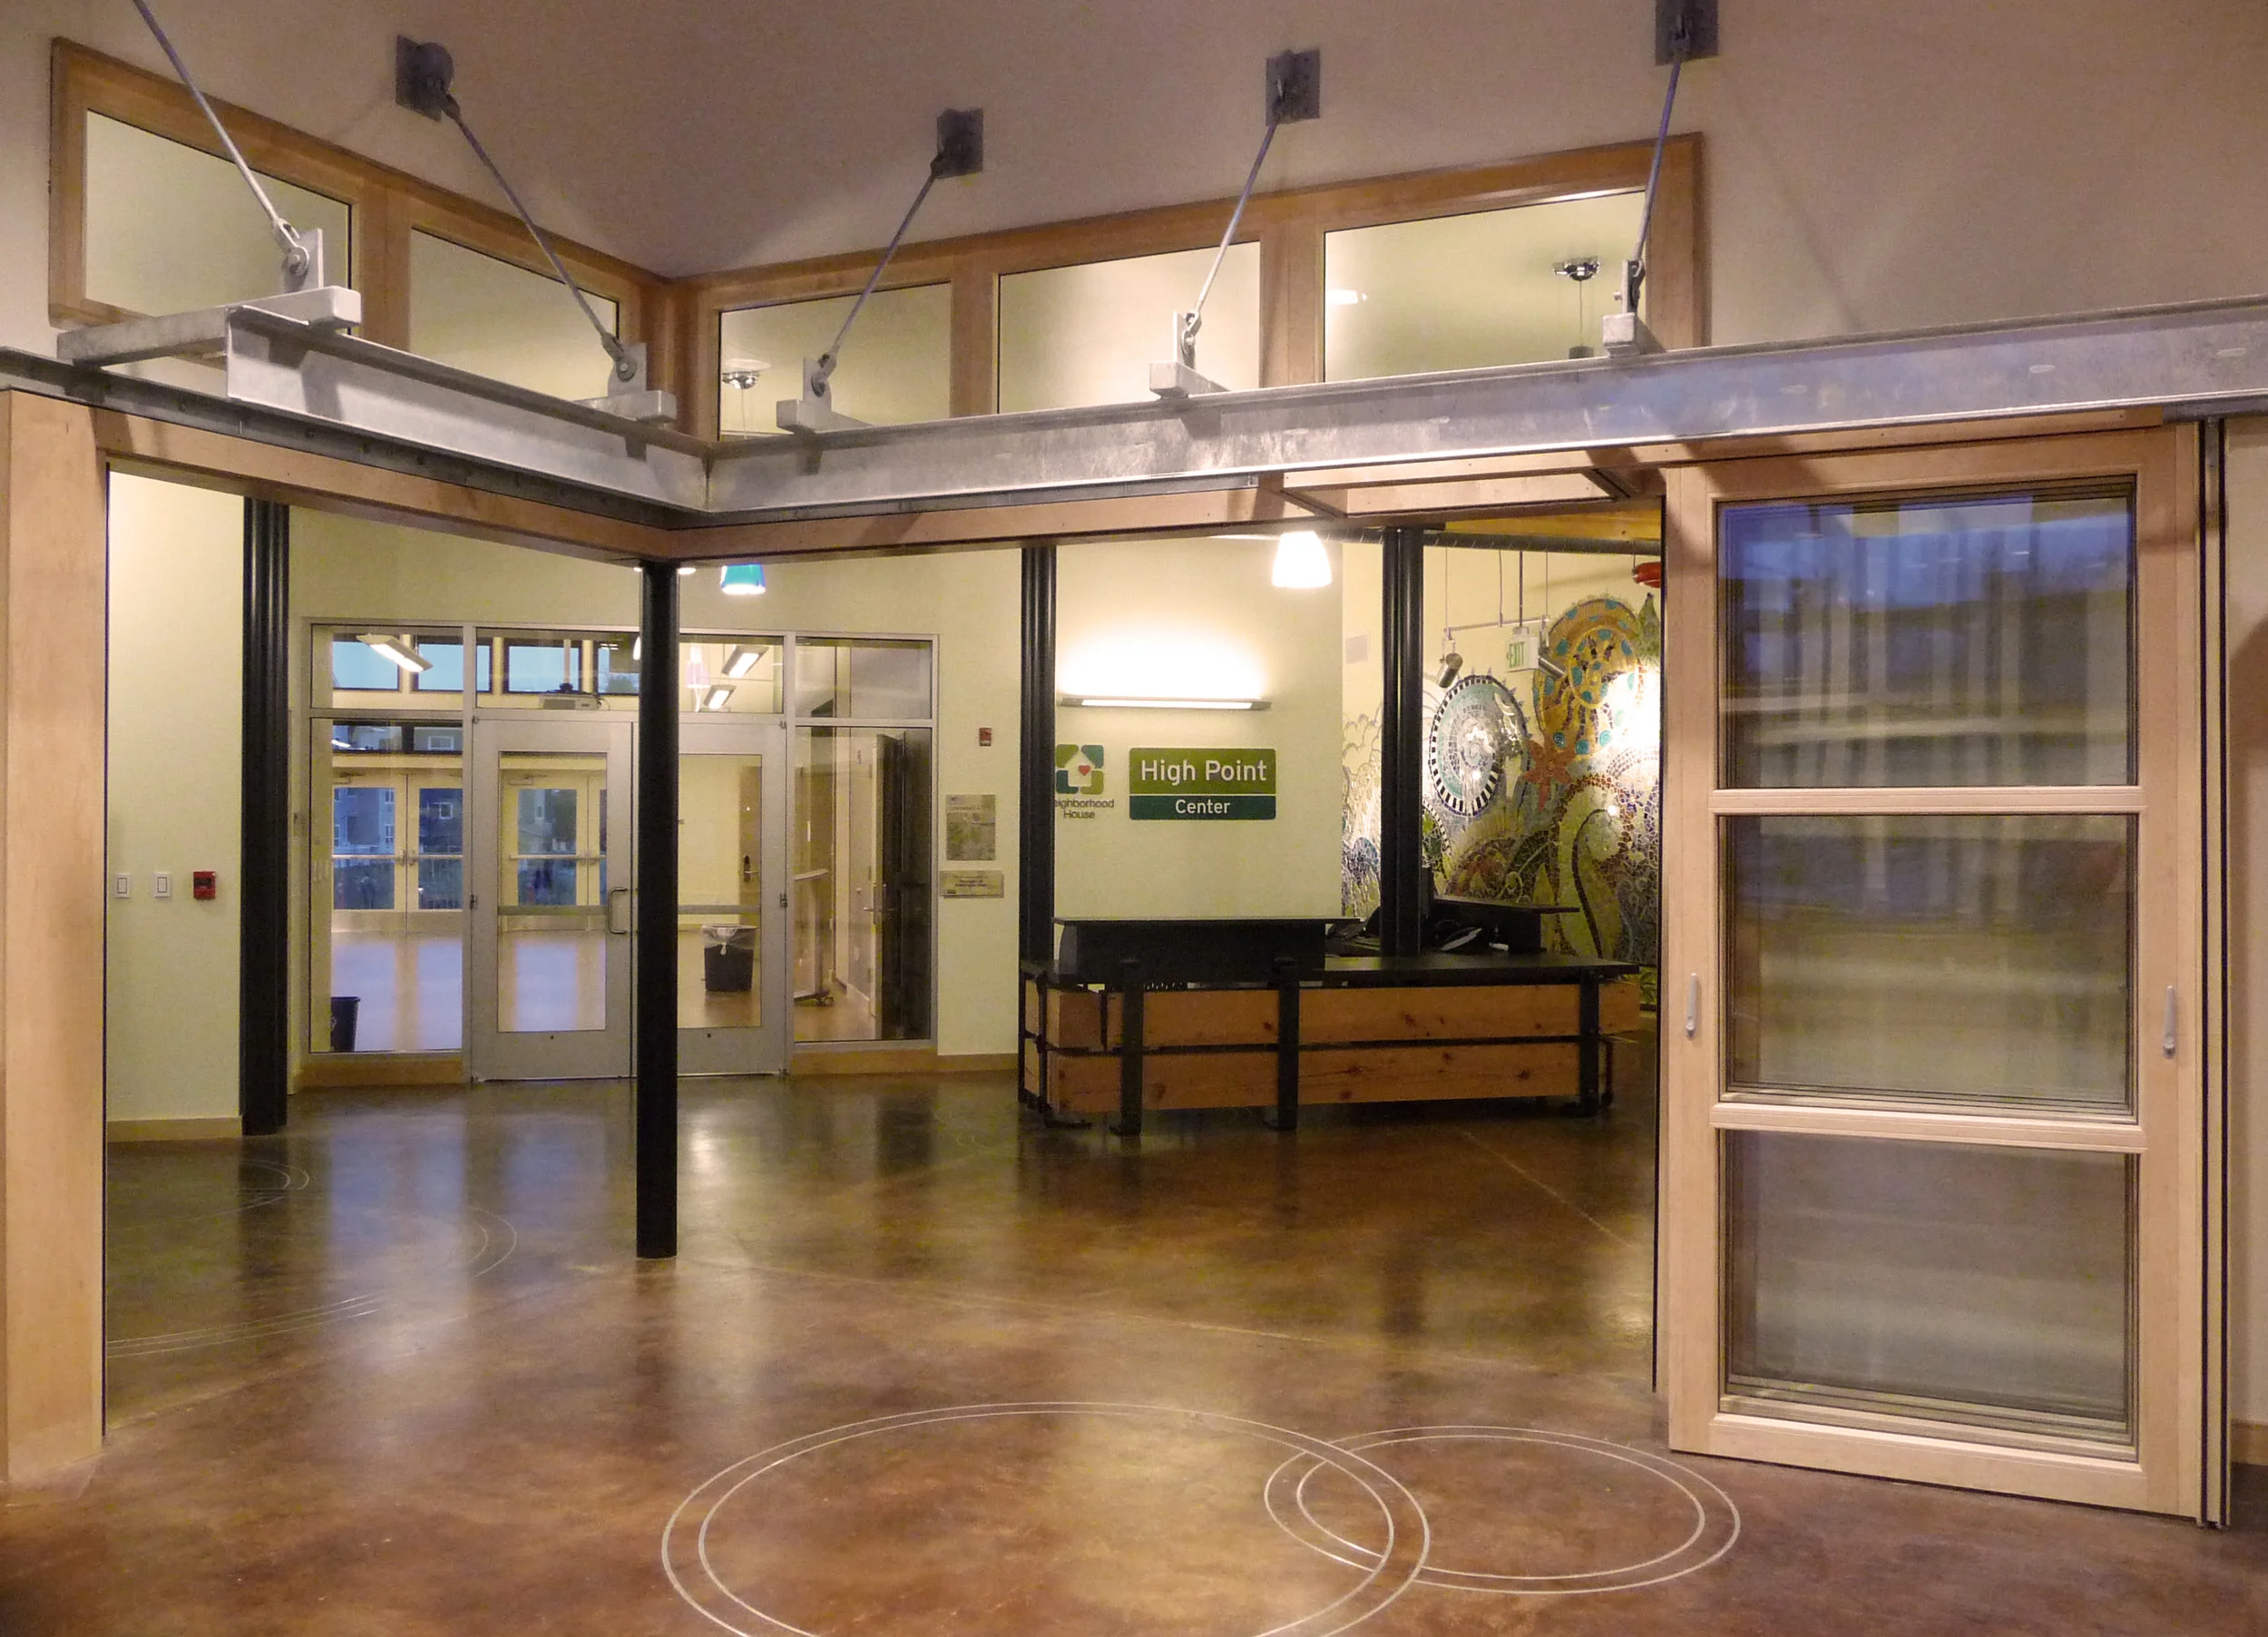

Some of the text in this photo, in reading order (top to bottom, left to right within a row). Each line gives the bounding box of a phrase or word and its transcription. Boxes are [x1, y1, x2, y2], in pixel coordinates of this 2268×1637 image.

[1509, 642, 1525, 668] EXIT
[1141, 759, 1267, 786] High Point
[1055, 799, 1115, 809] eighborhood
[1175, 799, 1231, 815] Center
[1063, 809, 1096, 819] House
